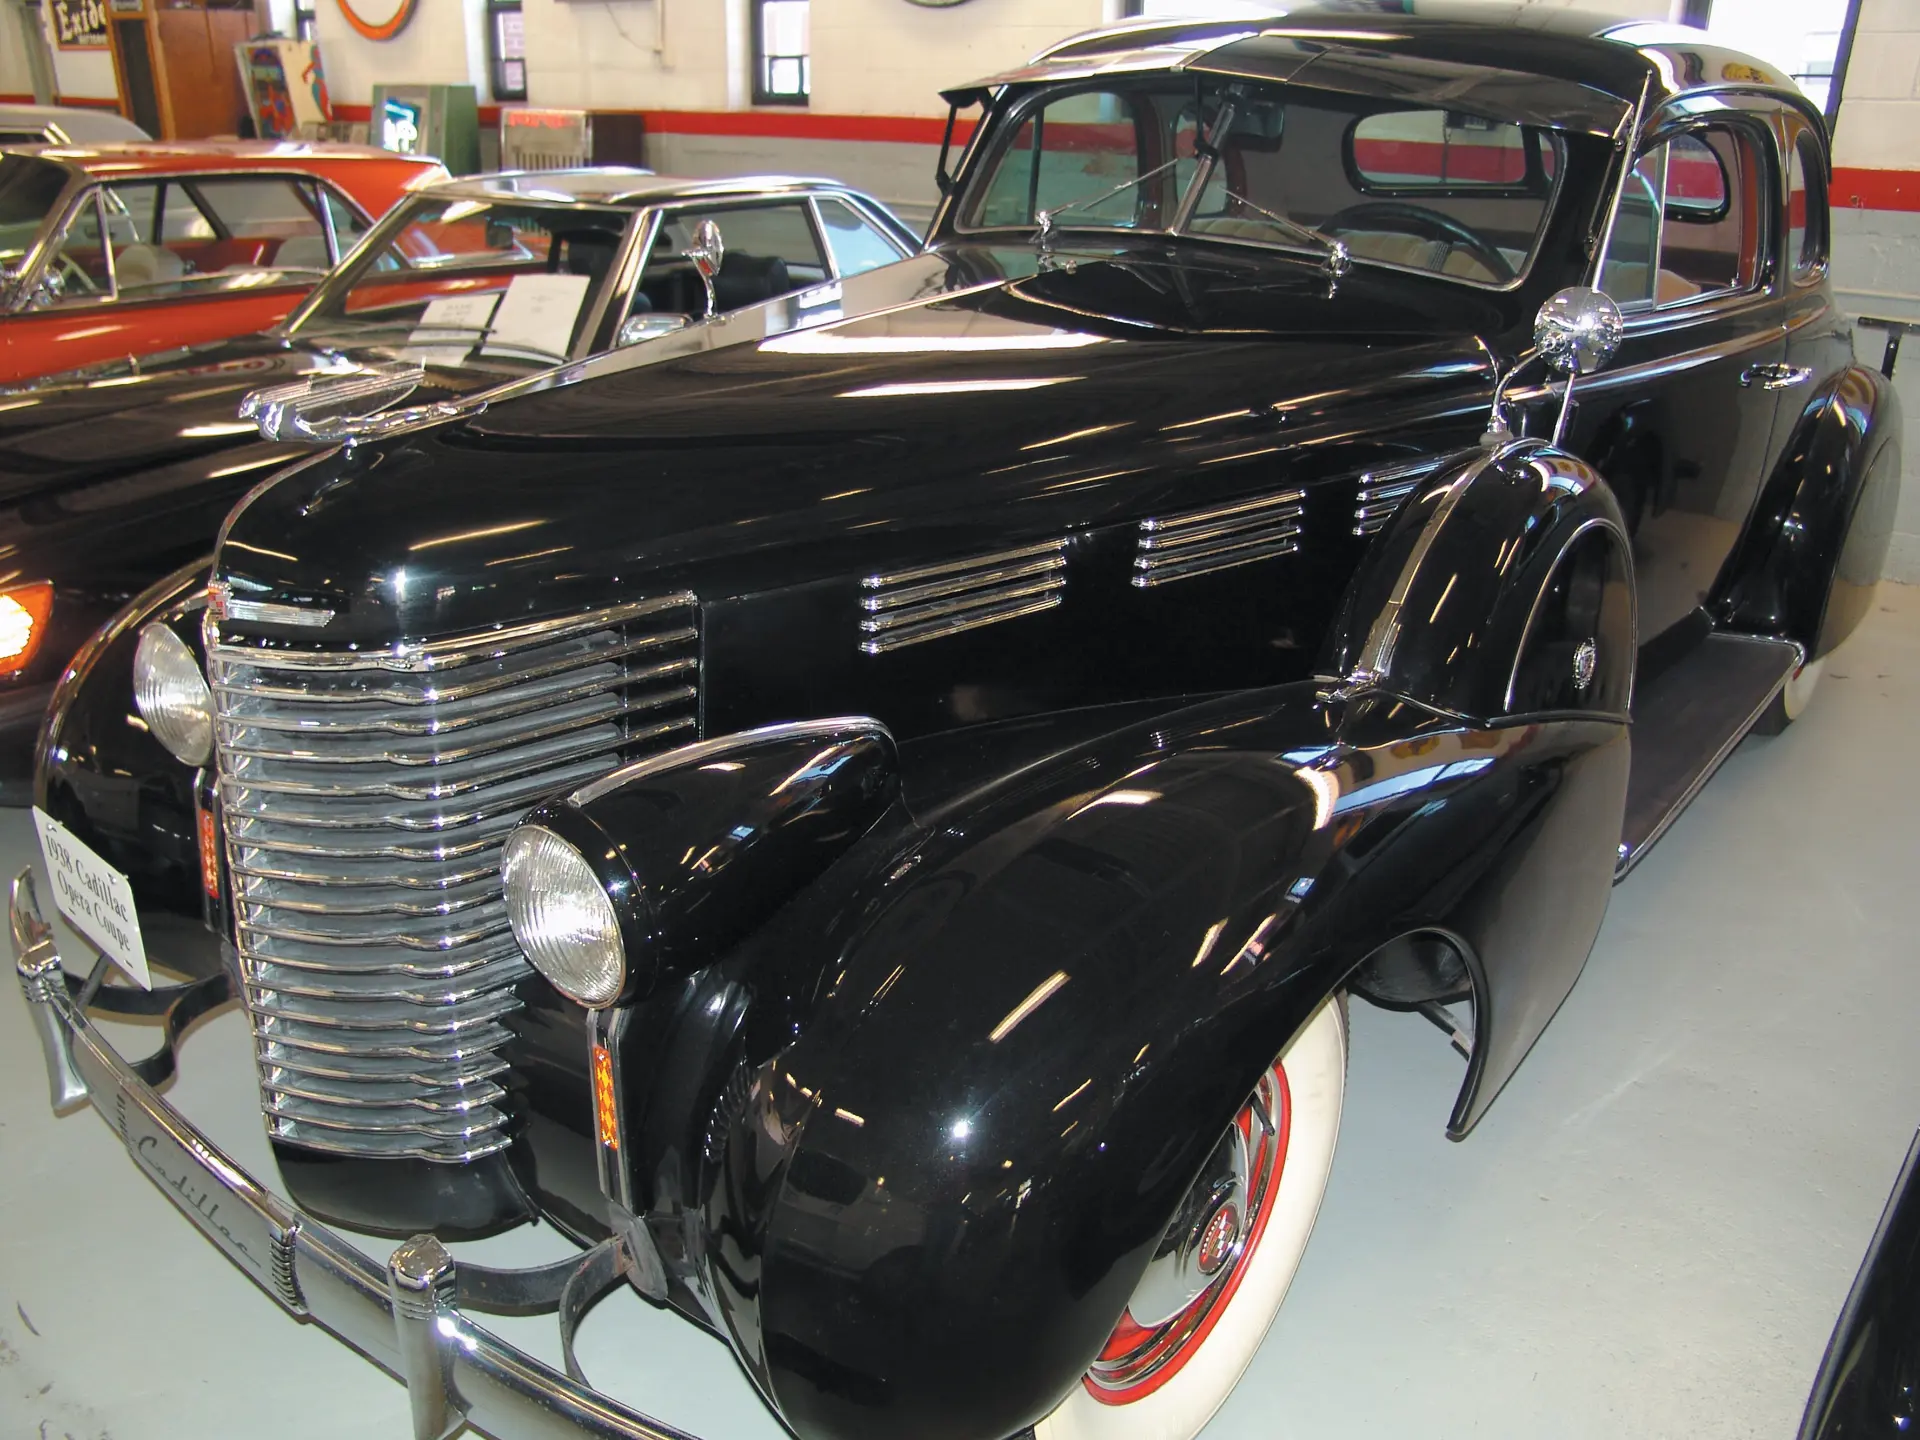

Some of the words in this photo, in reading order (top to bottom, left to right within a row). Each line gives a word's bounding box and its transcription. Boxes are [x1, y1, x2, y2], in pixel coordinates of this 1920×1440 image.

[45, 834, 73, 874] 1938
[75, 858, 129, 923] Cadillac
[57, 869, 92, 918] Opera
[94, 902, 131, 952] Coupe
[137, 1135, 262, 1270] Cadillac
